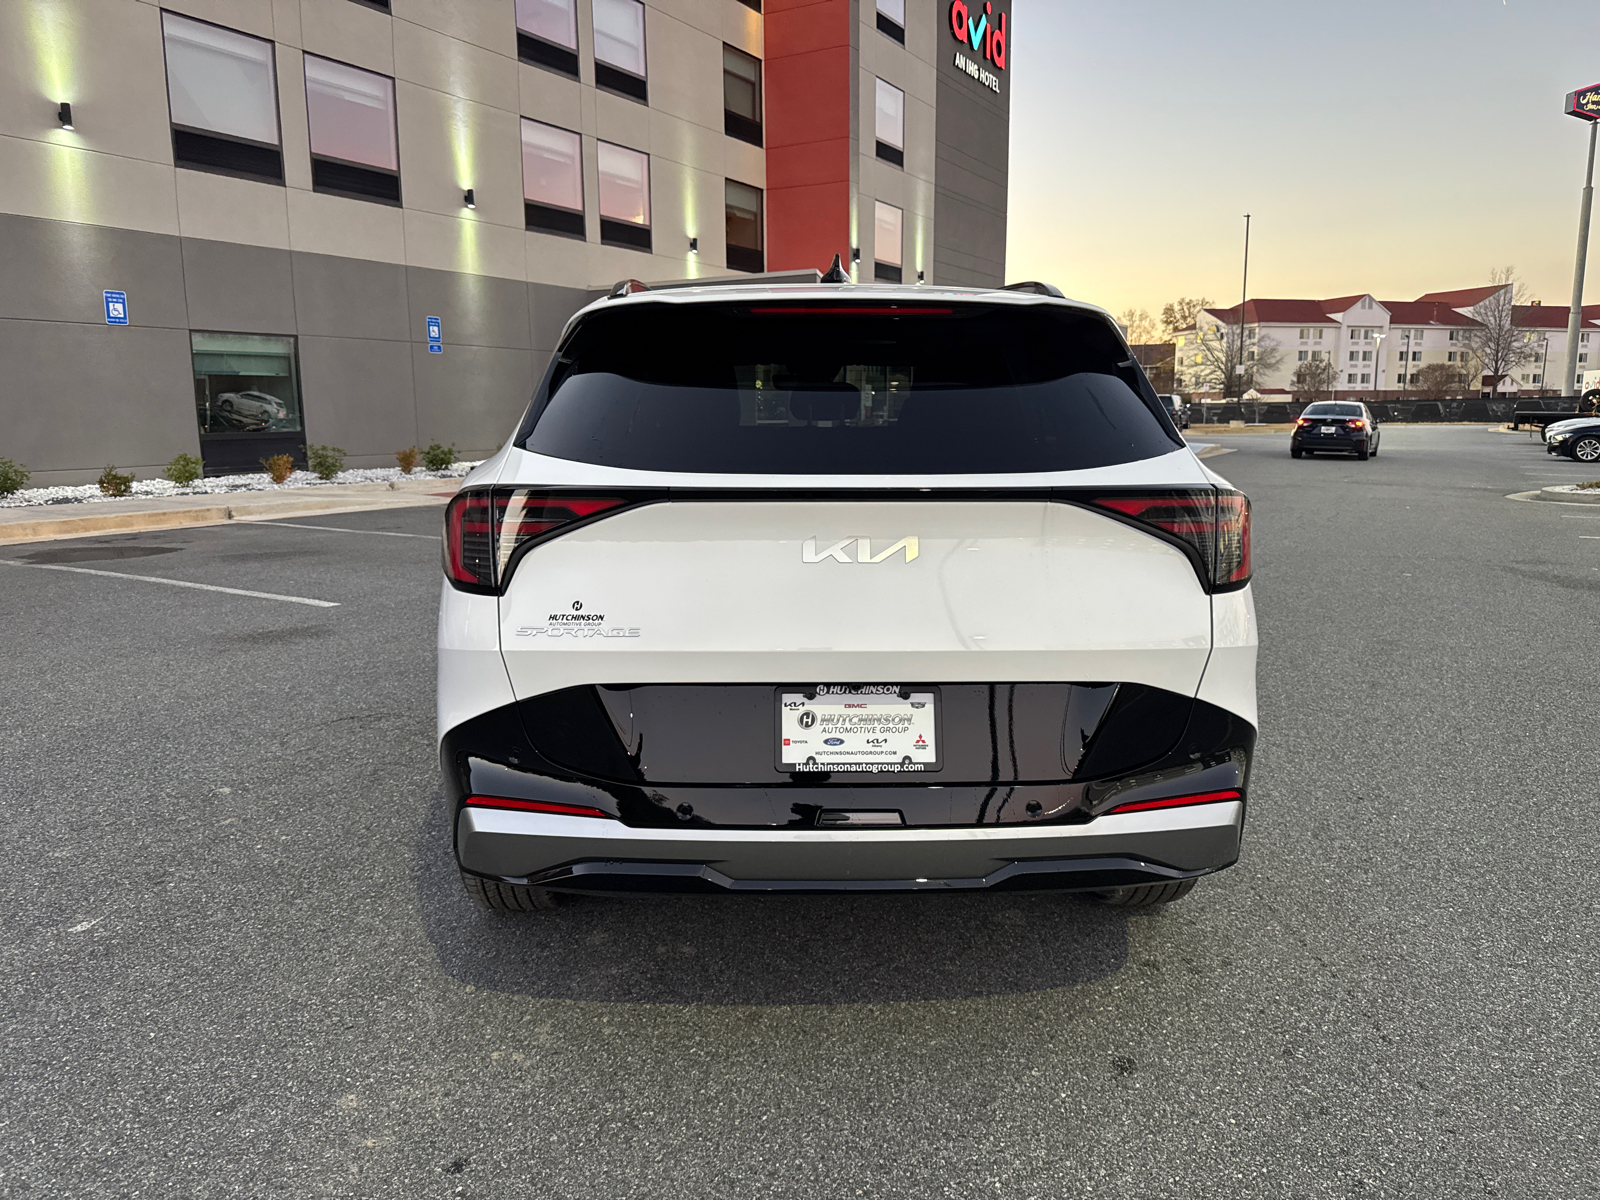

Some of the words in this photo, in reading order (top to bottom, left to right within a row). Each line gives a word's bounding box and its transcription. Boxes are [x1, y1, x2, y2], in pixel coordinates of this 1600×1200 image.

[952, 0, 1006, 70] avid
[955, 52, 966, 71] AN
[966, 58, 979, 79] IHG
[980, 67, 1000, 93] HOTEL
[802, 535, 919, 564] KIA
[548, 614, 605, 622] HUTCHINSON
[516, 626, 641, 638] SPORTAGE
[819, 714, 913, 726] HUTCHINSON
[821, 726, 878, 734] AUTOMOTIVE
[879, 726, 909, 734] GROUP
[795, 763, 925, 774] Hutchinsonautogroup.com
